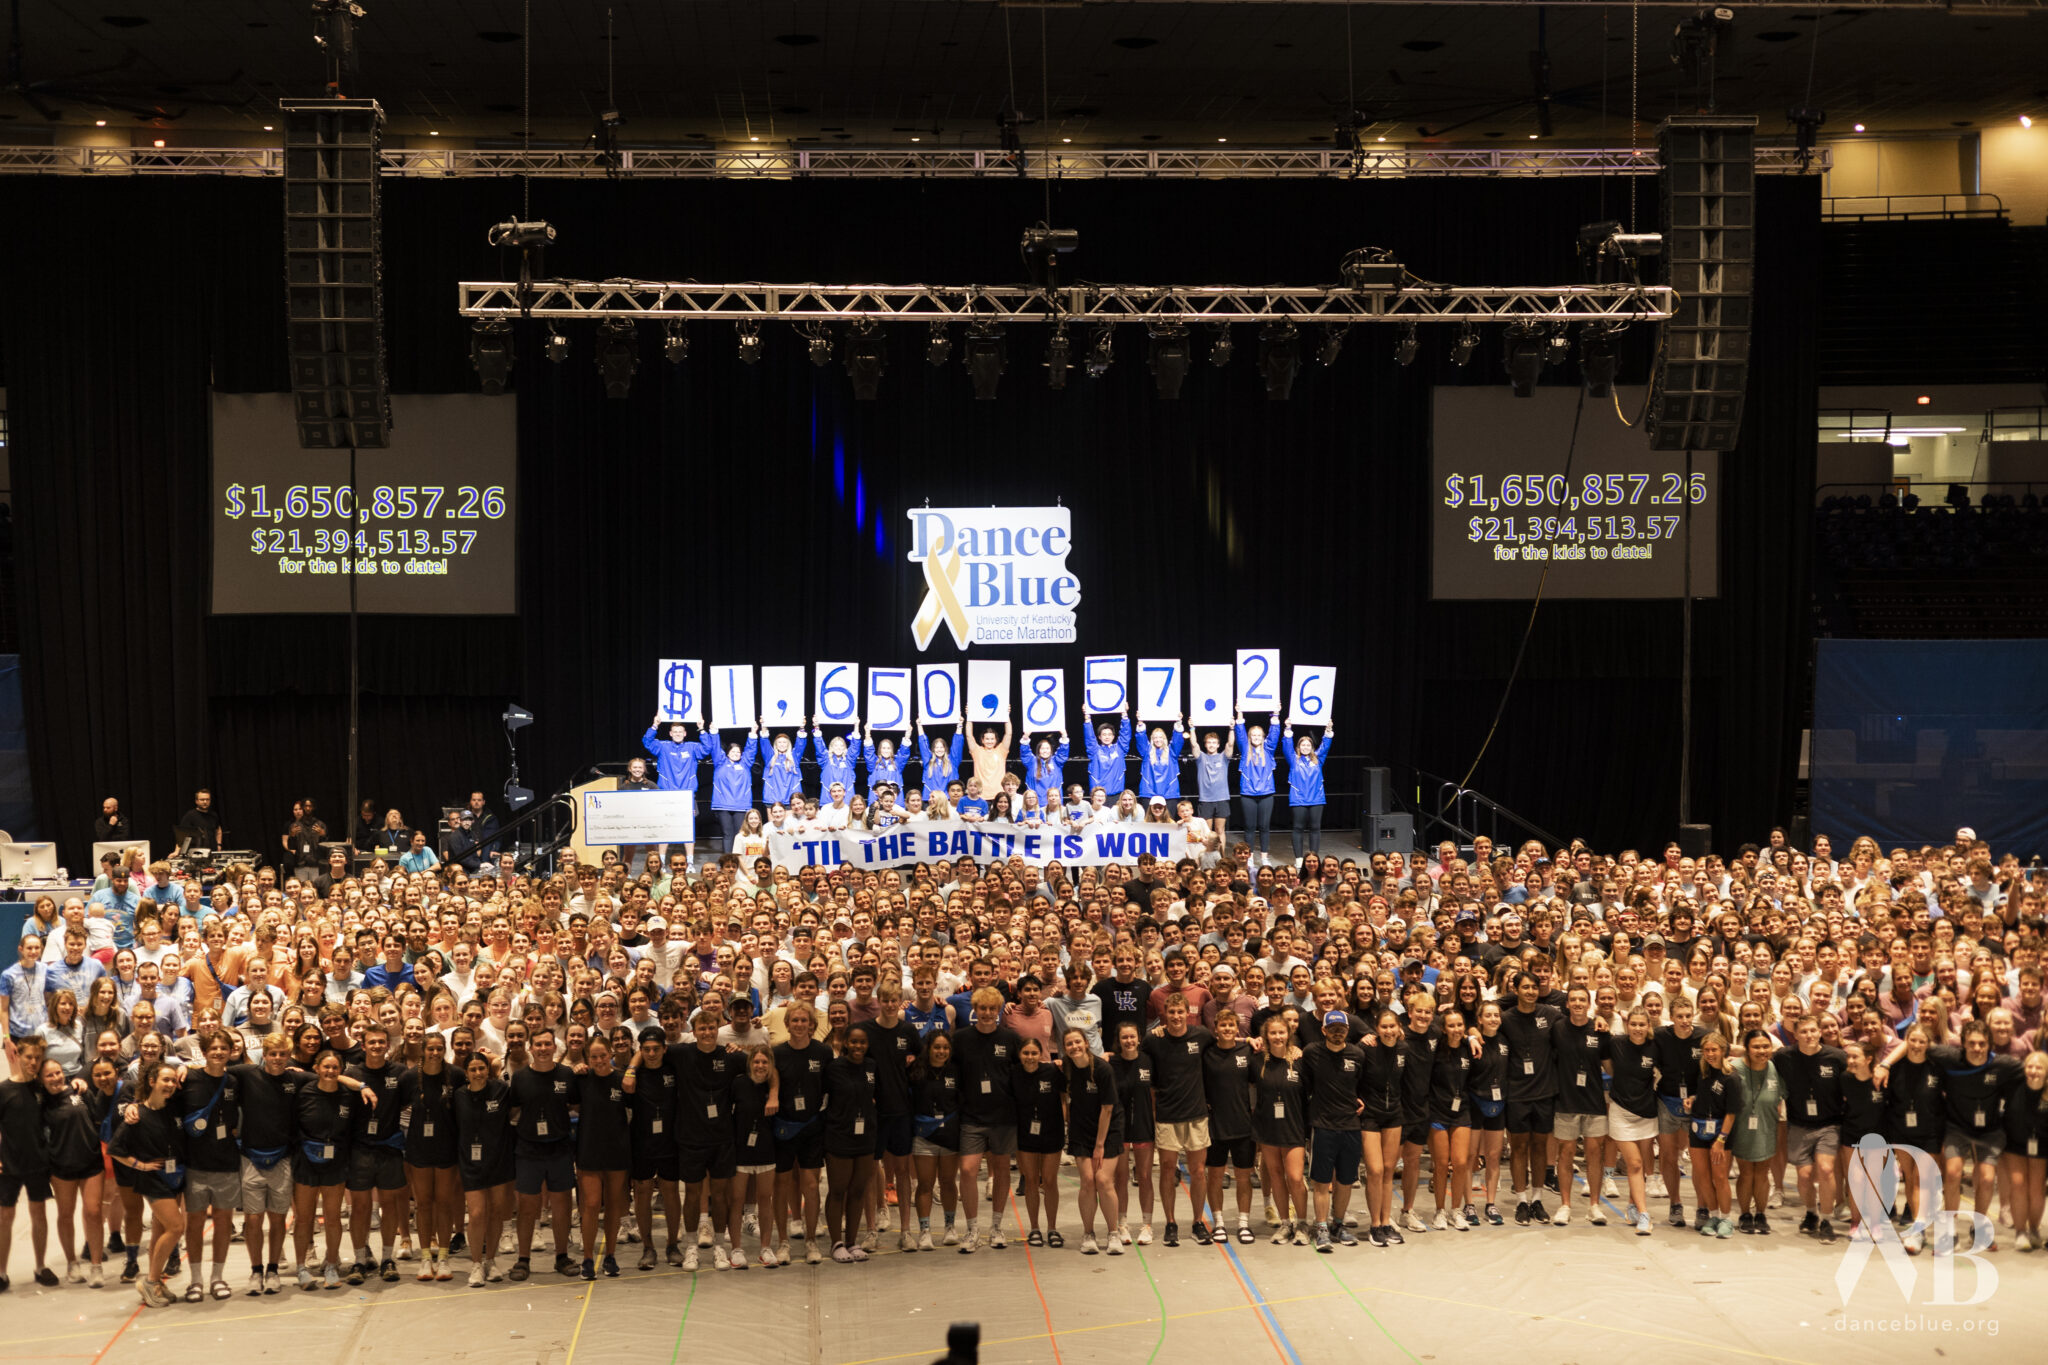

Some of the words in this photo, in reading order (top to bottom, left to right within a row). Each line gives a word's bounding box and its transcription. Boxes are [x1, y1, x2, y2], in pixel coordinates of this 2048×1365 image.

[225, 483, 506, 523] $1,650,857.26
[1445, 473, 1707, 511] $1,650,857.26
[251, 528, 477, 557] $21,394,513.57
[912, 513, 1067, 557] Dance
[1468, 515, 1680, 543] $21,394,513.57
[279, 558, 305, 574] for
[309, 558, 337, 574] the
[382, 560, 400, 574] to
[405, 558, 448, 574] date!
[1494, 544, 1518, 560] for
[1522, 544, 1548, 560] the
[1553, 544, 1586, 560] kids
[1590, 547, 1608, 560] to
[1612, 544, 1652, 560] date!
[965, 562, 1076, 607] Blue
[976, 614, 1019, 627] University
[1021, 614, 1030, 624] of
[1032, 613, 1072, 625] Kentucky
[976, 627, 1014, 640] Dance
[1017, 626, 1073, 640] Marathon
[859, 832, 916, 863] THE
[928, 829, 1041, 860] BATTLE
[1053, 834, 1083, 859] IS
[1096, 832, 1168, 857] WON
[1114, 991, 1137, 1011] UK
